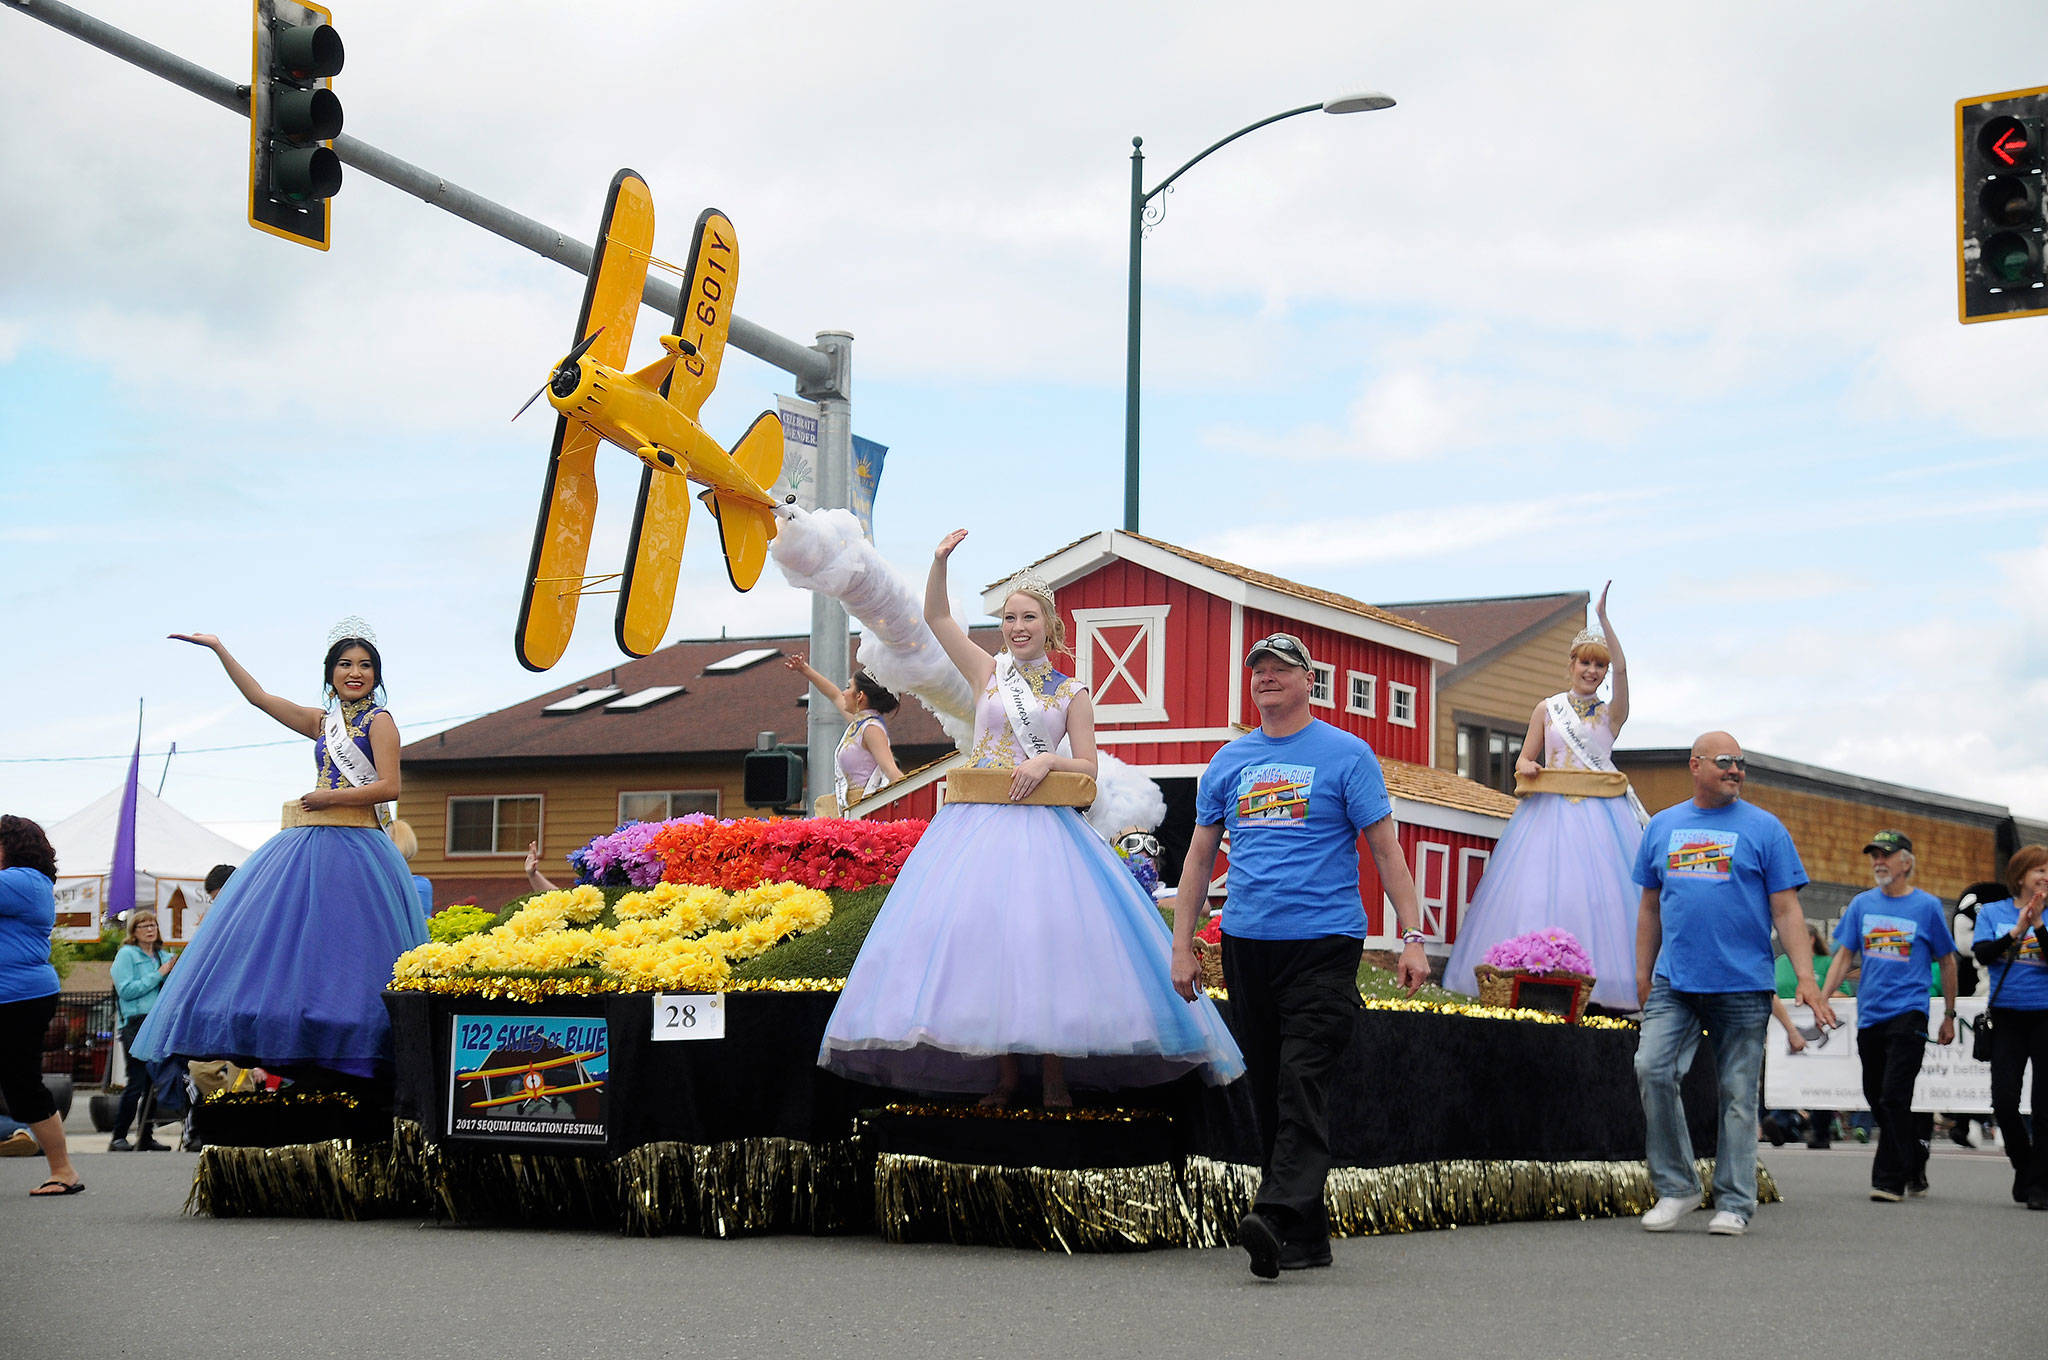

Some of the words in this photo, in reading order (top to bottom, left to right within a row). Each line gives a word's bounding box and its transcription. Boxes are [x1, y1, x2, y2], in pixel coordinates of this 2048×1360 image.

[782, 412, 815, 432] CELEBRATE
[1010, 686, 1031, 726] Princess
[333, 742, 356, 770] Queen
[1290, 769, 1312, 784] BLUE
[665, 1005, 697, 1028] 28
[462, 1023, 493, 1051] 122
[496, 1024, 546, 1054] SKIES
[564, 1026, 607, 1053] BLUE
[455, 1119, 475, 1130] 2017
[476, 1119, 511, 1133] SEQUIM
[511, 1121, 563, 1134] IRRIGATION
[563, 1123, 605, 1136] FESTIVAL
